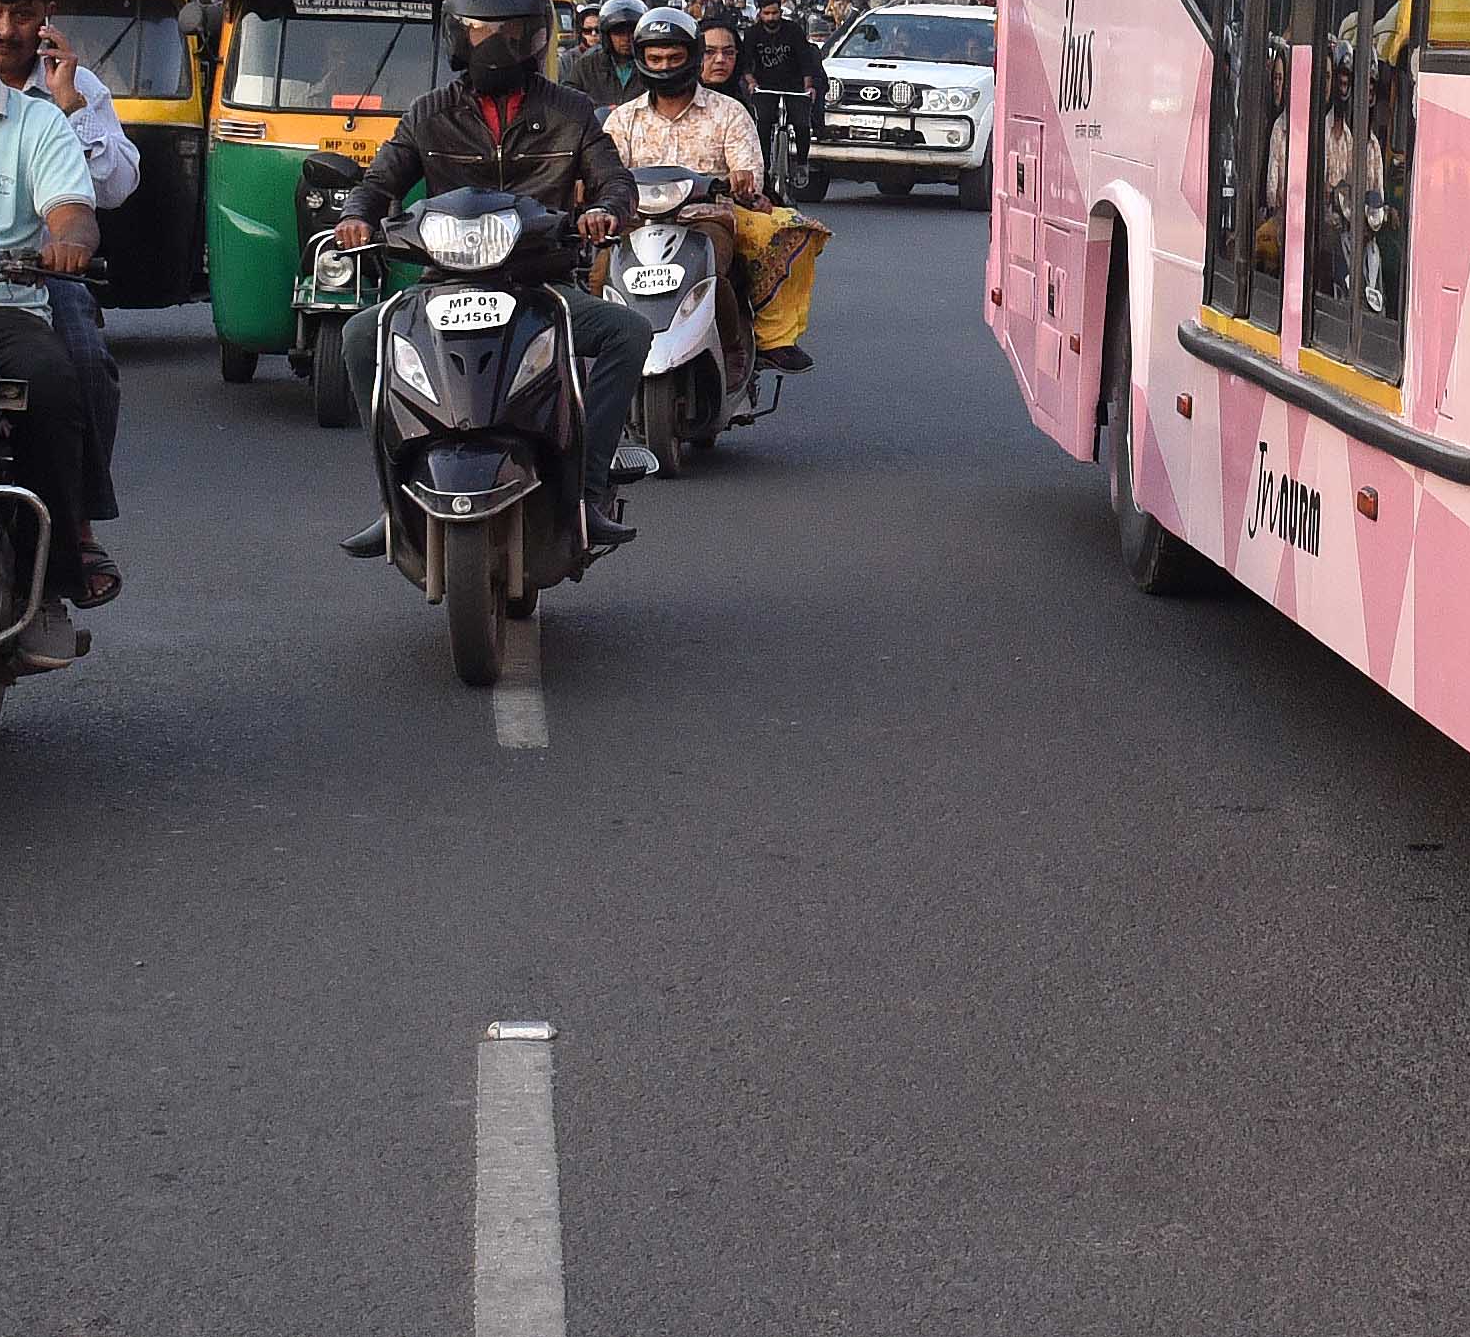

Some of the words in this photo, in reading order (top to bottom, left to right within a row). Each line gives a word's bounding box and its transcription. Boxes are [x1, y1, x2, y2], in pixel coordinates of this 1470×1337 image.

[325, 140, 343, 150] MP
[352, 141, 367, 151] 09
[449, 296, 473, 309] MP
